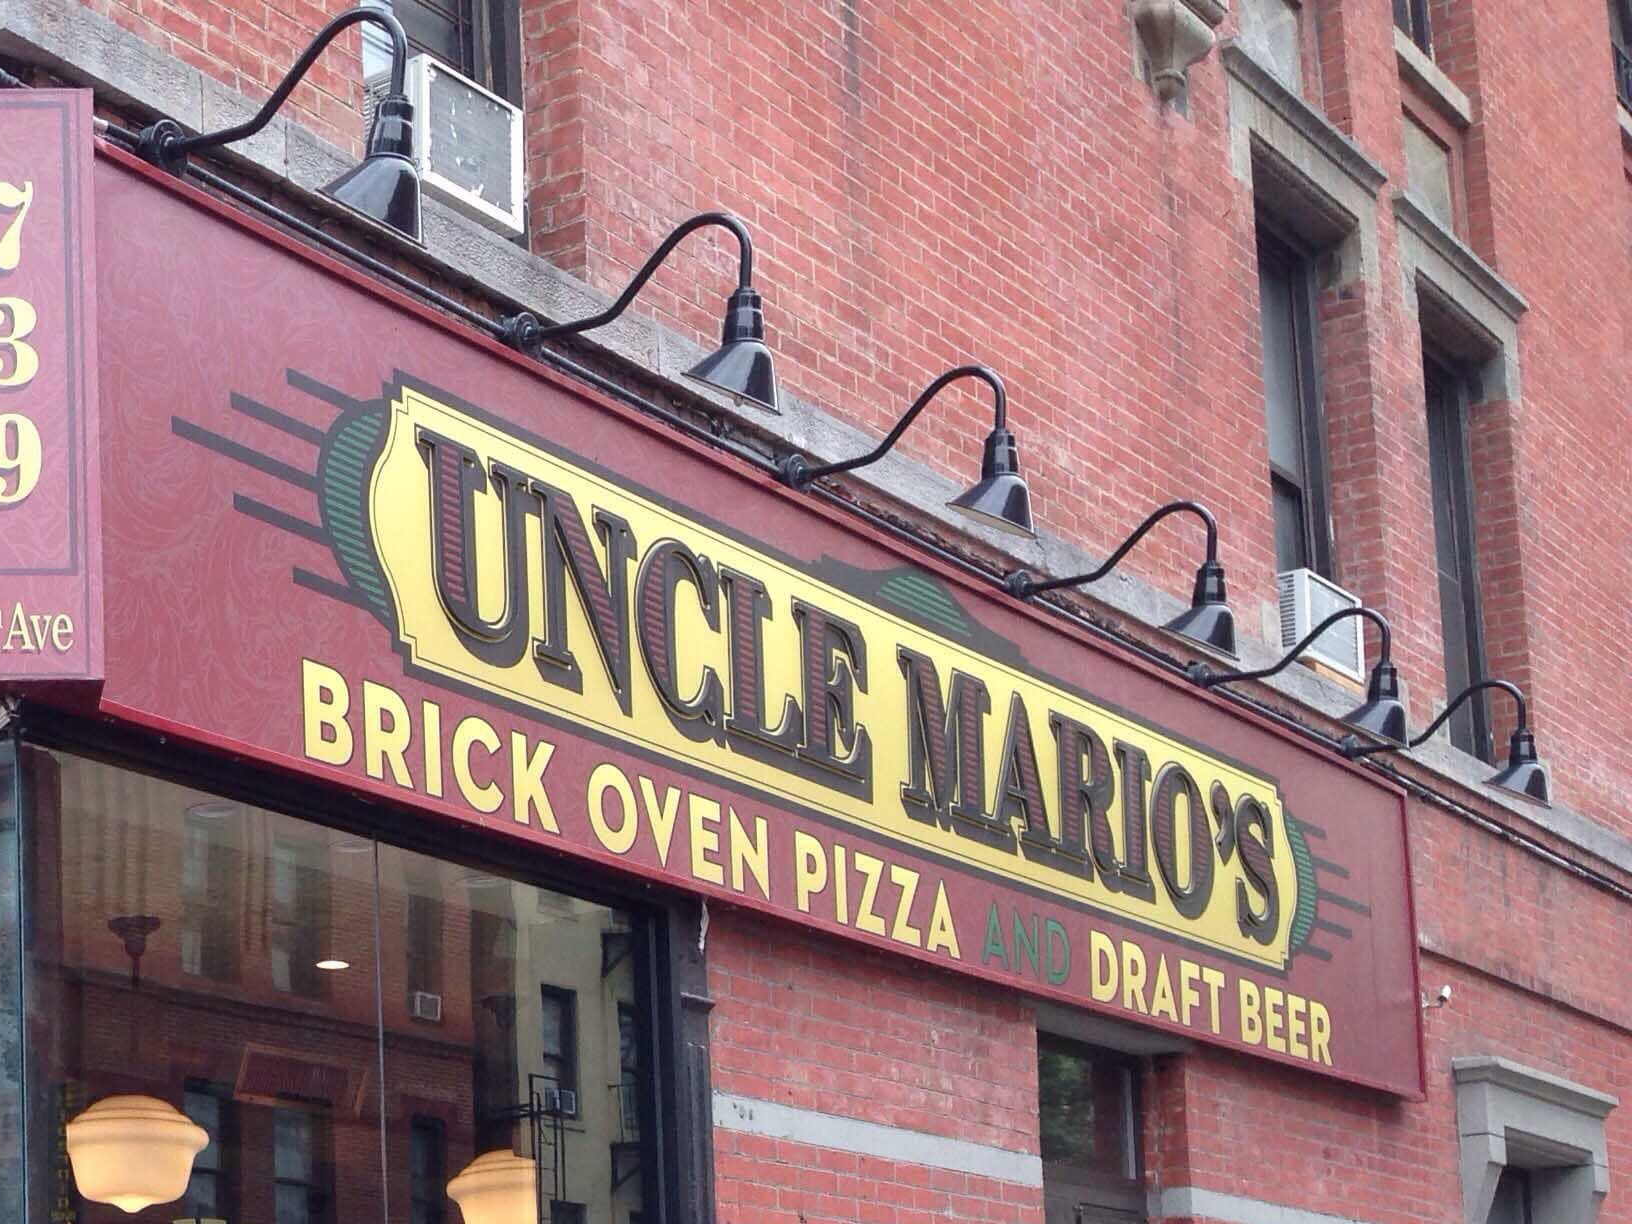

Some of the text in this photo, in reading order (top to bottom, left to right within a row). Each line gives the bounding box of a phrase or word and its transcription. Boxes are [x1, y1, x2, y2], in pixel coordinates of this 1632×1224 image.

[4, 602, 74, 652] Ave
[415, 423, 1281, 945] UNCLE MARIO'S
[302, 657, 1333, 1066] BRICK OVEN PIZZA AND DRAFT BEER
